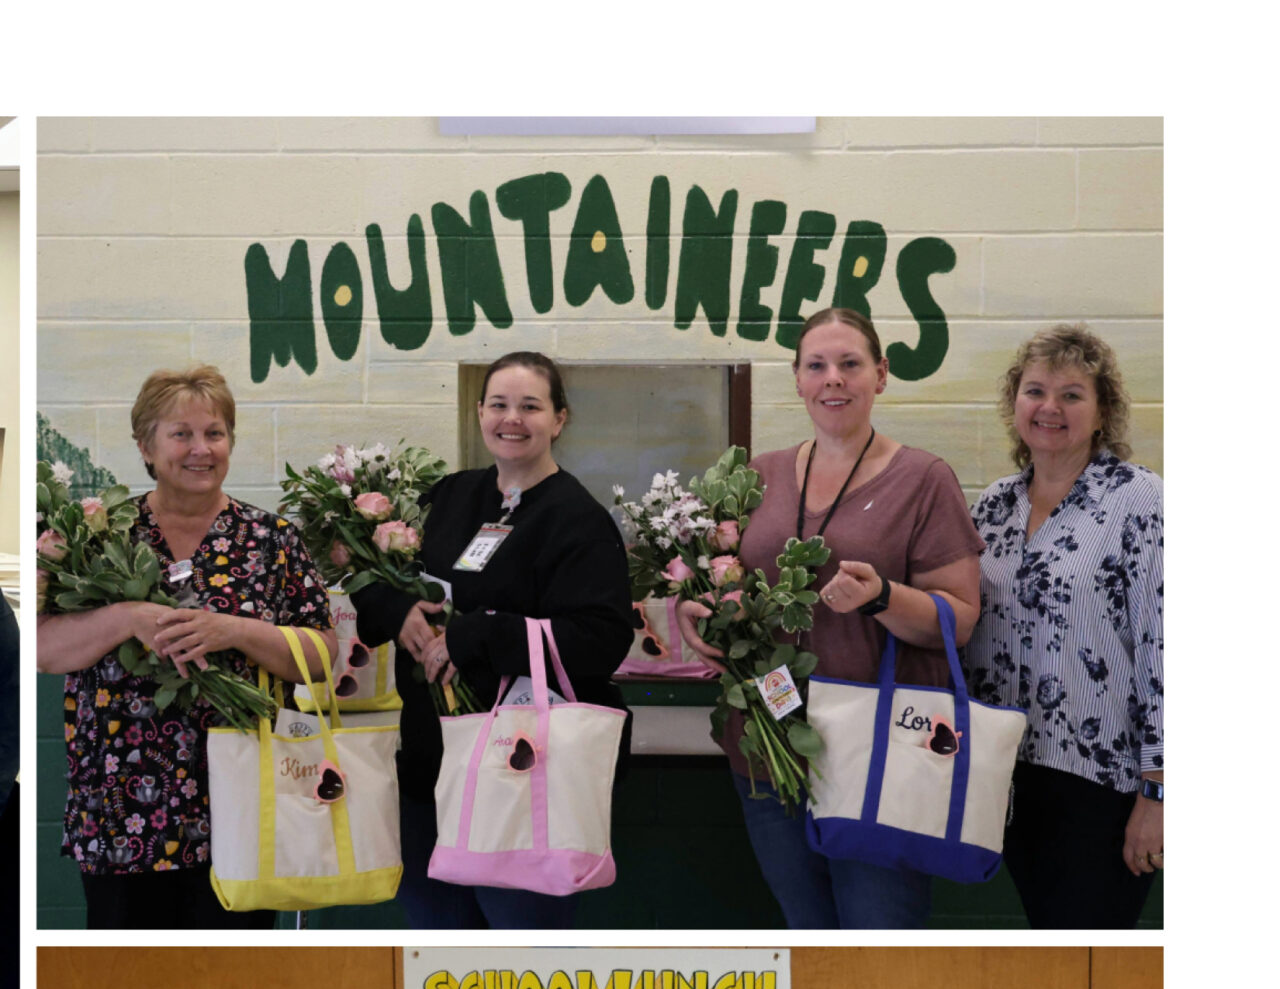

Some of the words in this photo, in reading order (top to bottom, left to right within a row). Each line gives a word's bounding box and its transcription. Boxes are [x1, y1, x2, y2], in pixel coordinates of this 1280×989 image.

[244, 172, 957, 383] MOUNTAINEERS
[895, 706, 933, 732] Lor
[280, 756, 320, 780] Kim
